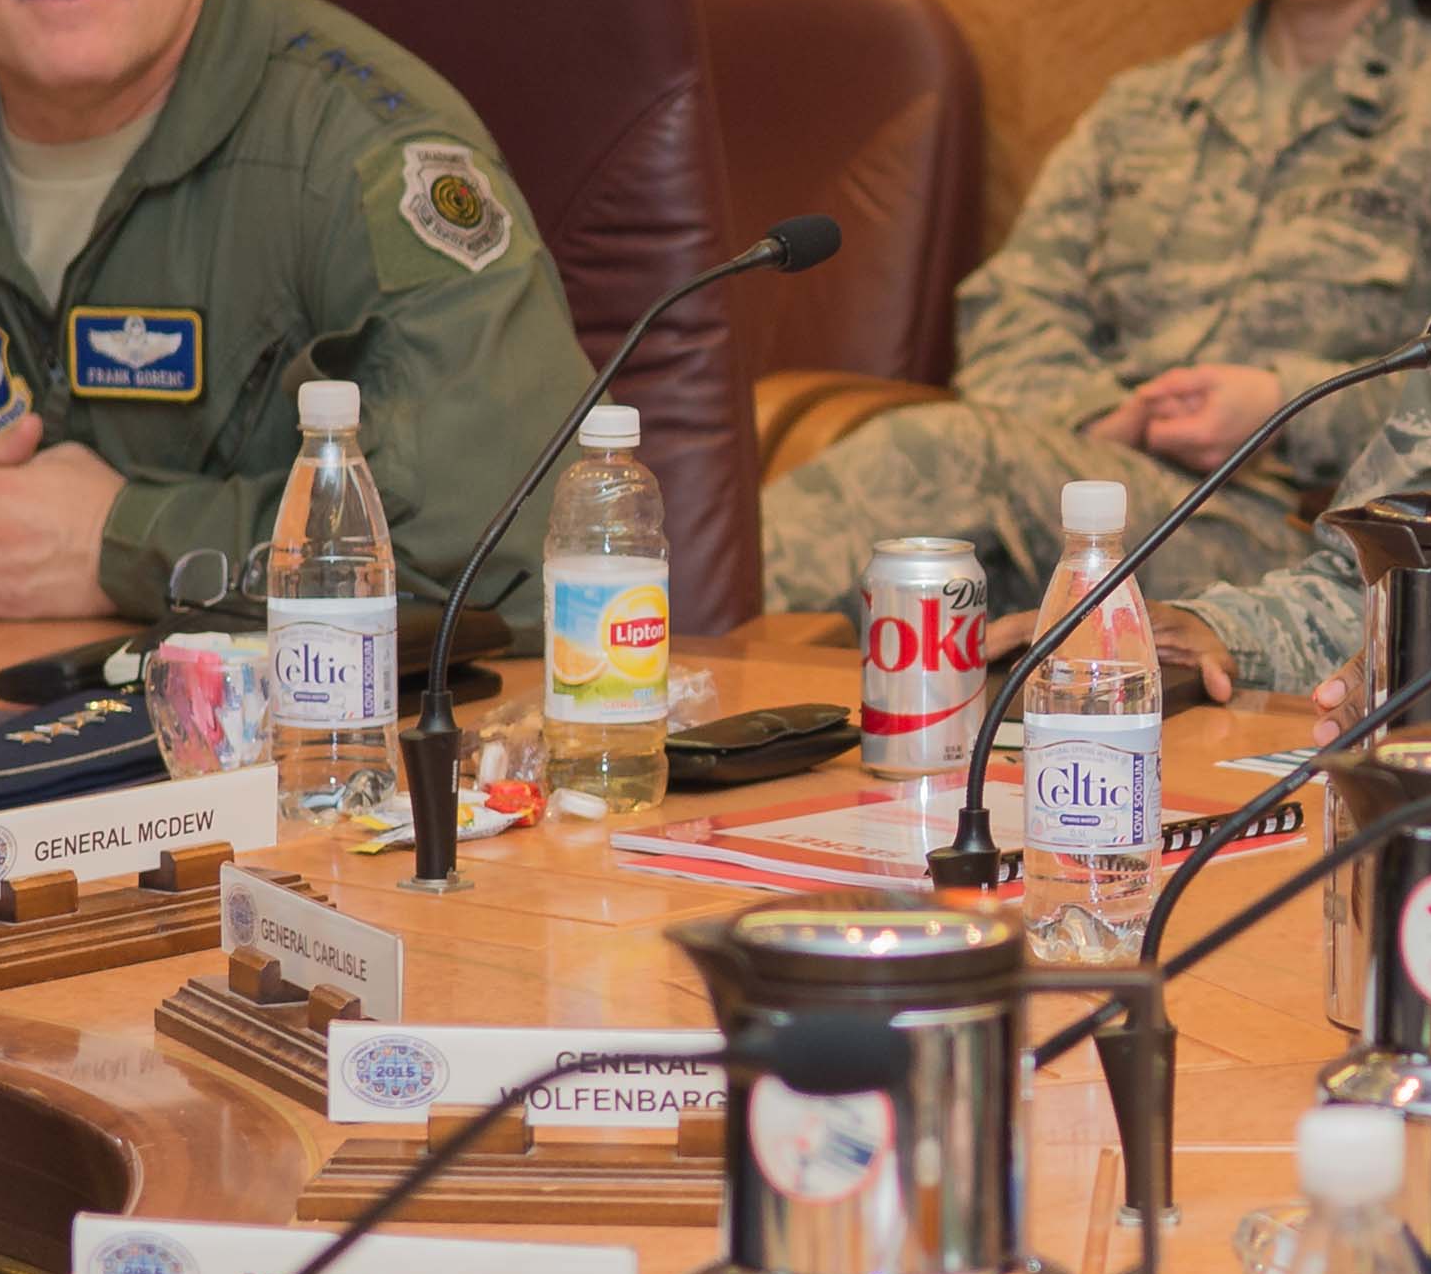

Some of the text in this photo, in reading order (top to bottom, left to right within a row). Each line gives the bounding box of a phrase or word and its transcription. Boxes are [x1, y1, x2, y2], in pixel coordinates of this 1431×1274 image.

[616, 623, 664, 645] Lipton
[275, 644, 356, 684] Celtic
[1037, 762, 1130, 808] Celtic
[1134, 759, 1143, 839] LOW SODIUM
[34, 810, 215, 862] GENERAL MCDEW
[261, 918, 368, 982] GENERAL CARLISLE
[375, 1066, 416, 1078] 2015
